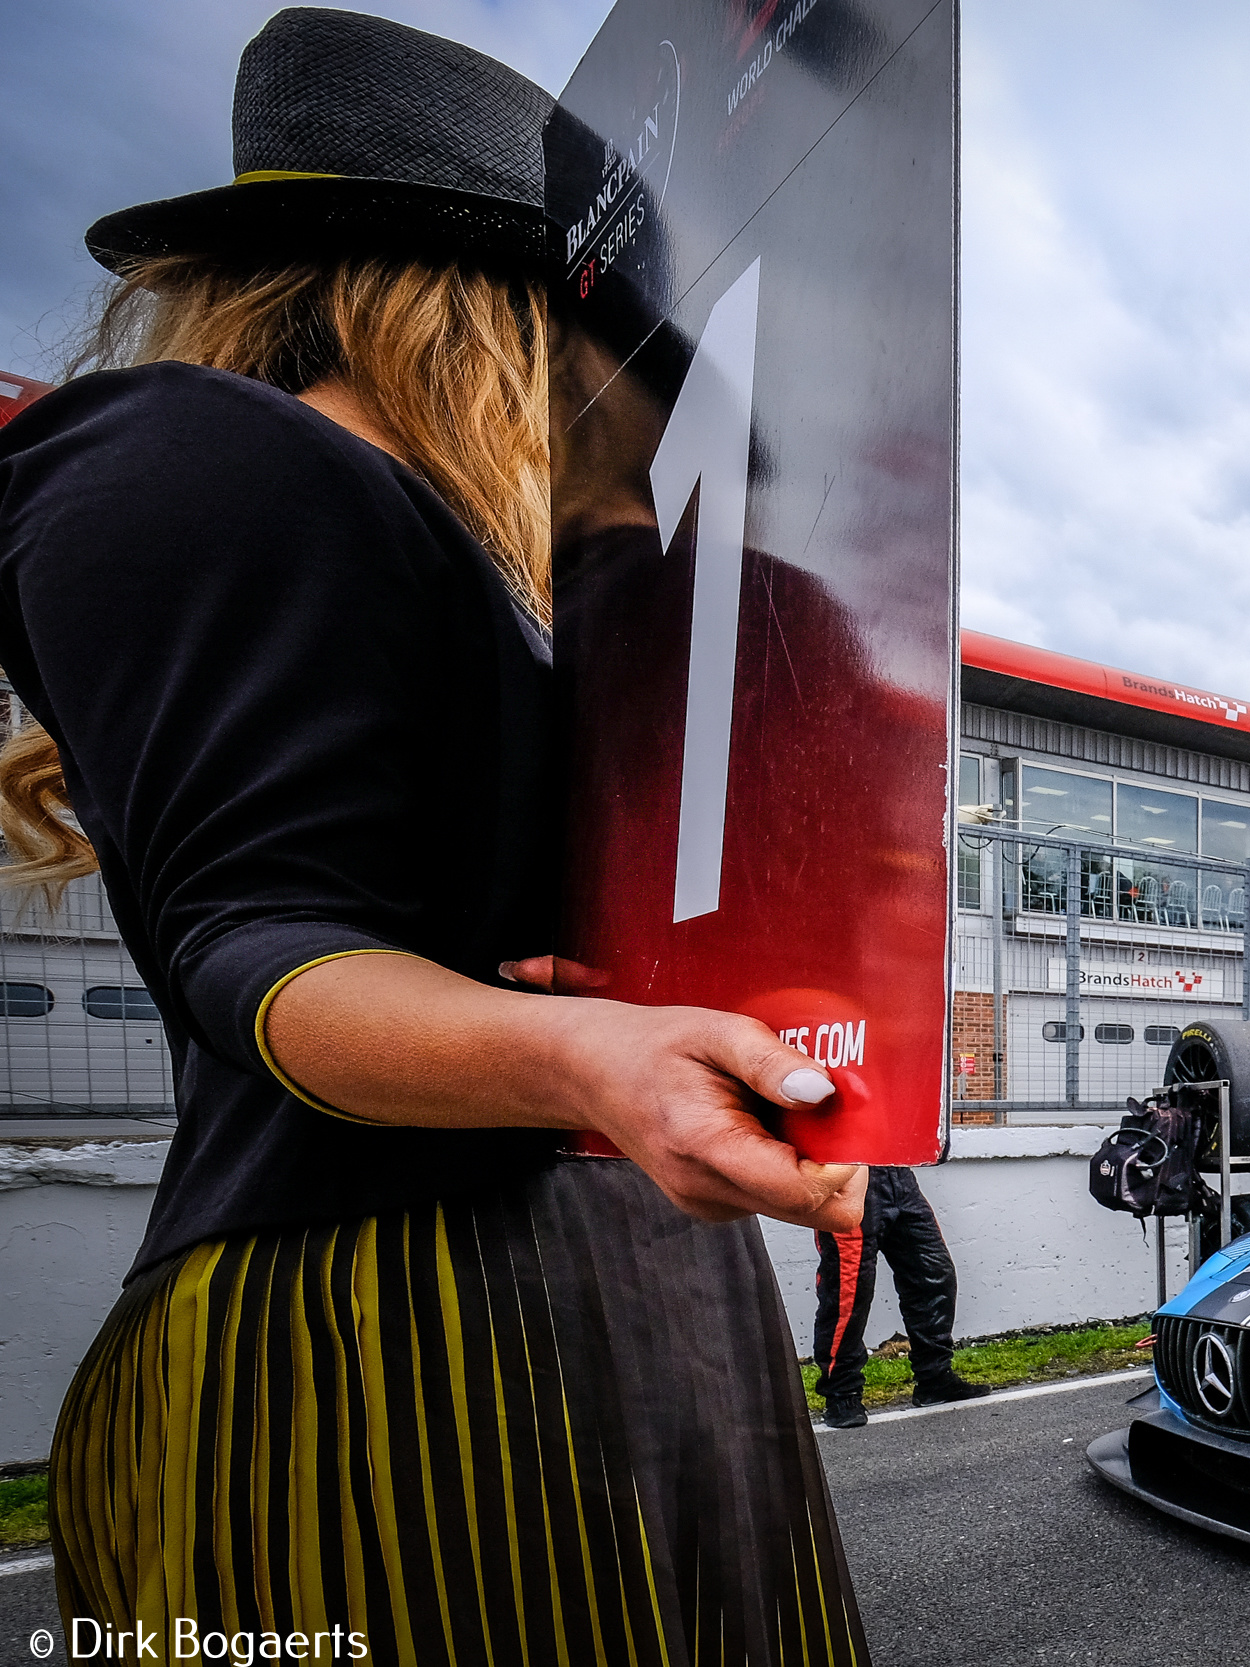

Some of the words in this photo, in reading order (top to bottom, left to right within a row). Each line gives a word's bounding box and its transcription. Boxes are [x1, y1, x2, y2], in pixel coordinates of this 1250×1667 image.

[727, 40, 773, 116] WORLD
[566, 102, 660, 265] BLANCPAIN
[579, 258, 596, 299] GT
[600, 193, 645, 274] SERIES
[649, 255, 761, 923] 1
[1122, 676, 1218, 710] BrandsHatch
[1079, 971, 1173, 989] BrandsHatch
[1137, 951, 1145, 962] 2
[1182, 1028, 1212, 1042] PIRELLI
